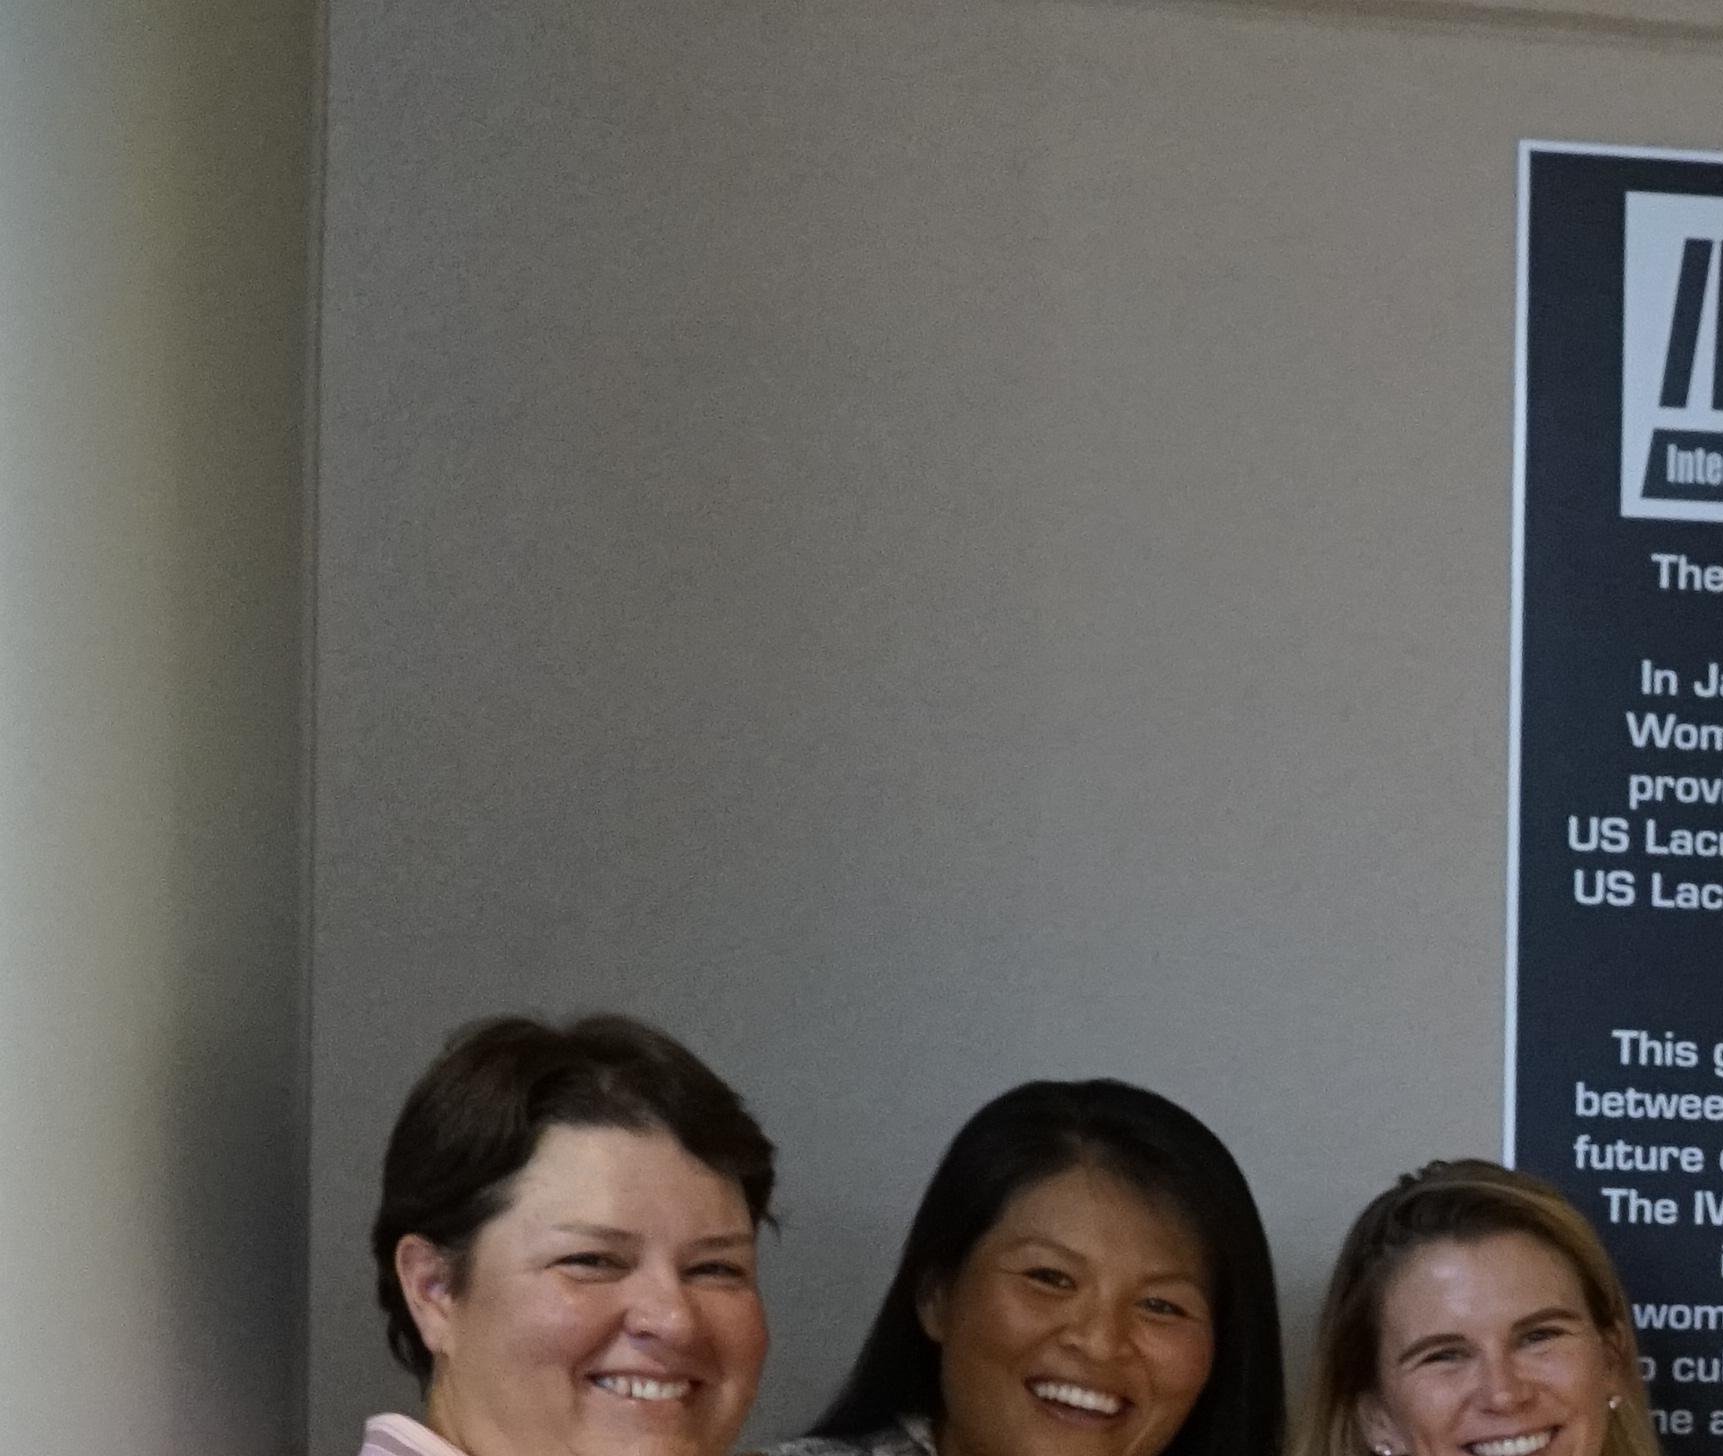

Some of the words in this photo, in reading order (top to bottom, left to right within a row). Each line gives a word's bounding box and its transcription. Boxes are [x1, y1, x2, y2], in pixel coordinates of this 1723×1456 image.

[1641, 659, 1678, 696] In
[1568, 815, 1630, 854] US
[1574, 868, 1636, 907] US
[1611, 1029, 1699, 1068] This
[1573, 1134, 1705, 1173] future
[1600, 1187, 1678, 1225] The
